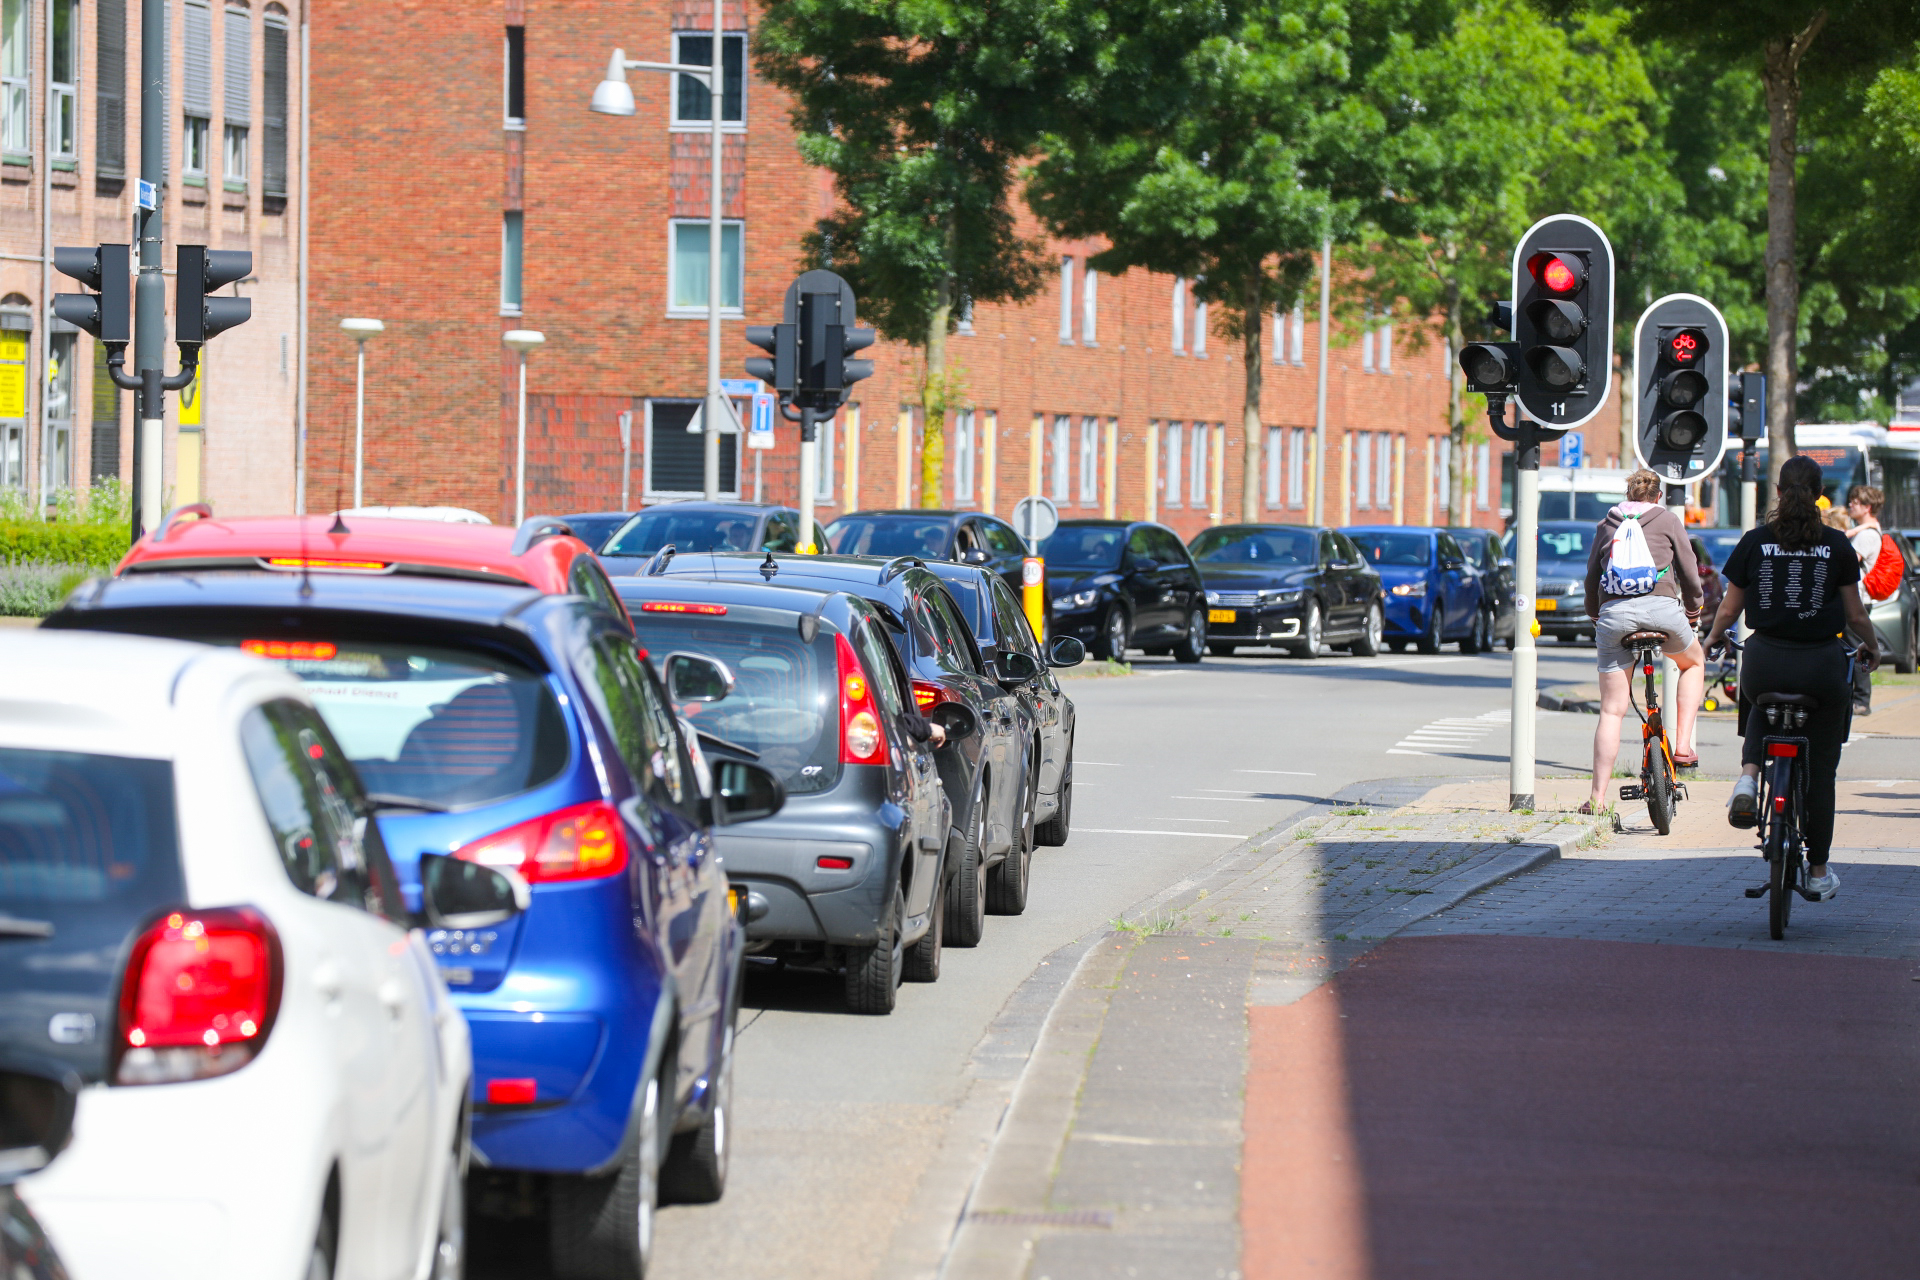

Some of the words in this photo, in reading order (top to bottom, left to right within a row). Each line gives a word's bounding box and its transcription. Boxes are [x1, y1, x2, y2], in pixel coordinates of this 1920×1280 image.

[1467, 384, 1475, 392] 11
[1550, 402, 1566, 416] 11
[1565, 434, 1578, 454] P
[801, 765, 823, 776] 07
